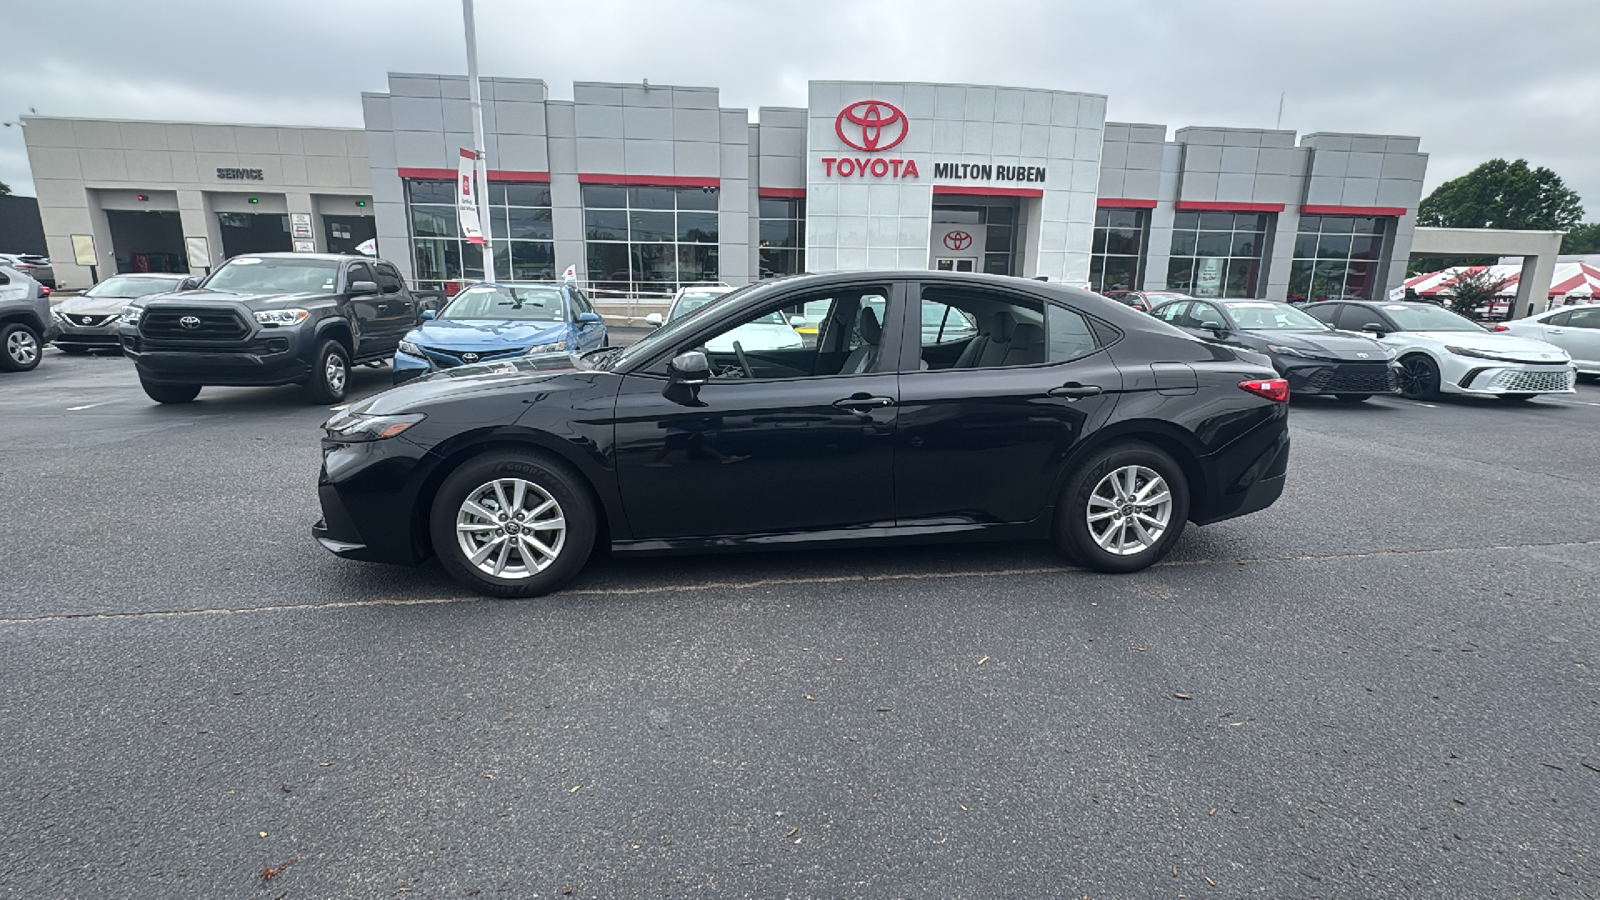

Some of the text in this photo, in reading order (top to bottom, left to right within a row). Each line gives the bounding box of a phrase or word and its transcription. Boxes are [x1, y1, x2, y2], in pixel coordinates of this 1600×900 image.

[216, 167, 264, 181] SERVICE
[821, 157, 919, 179] TOYOTA
[934, 162, 1046, 183] MILTON RUBEN
